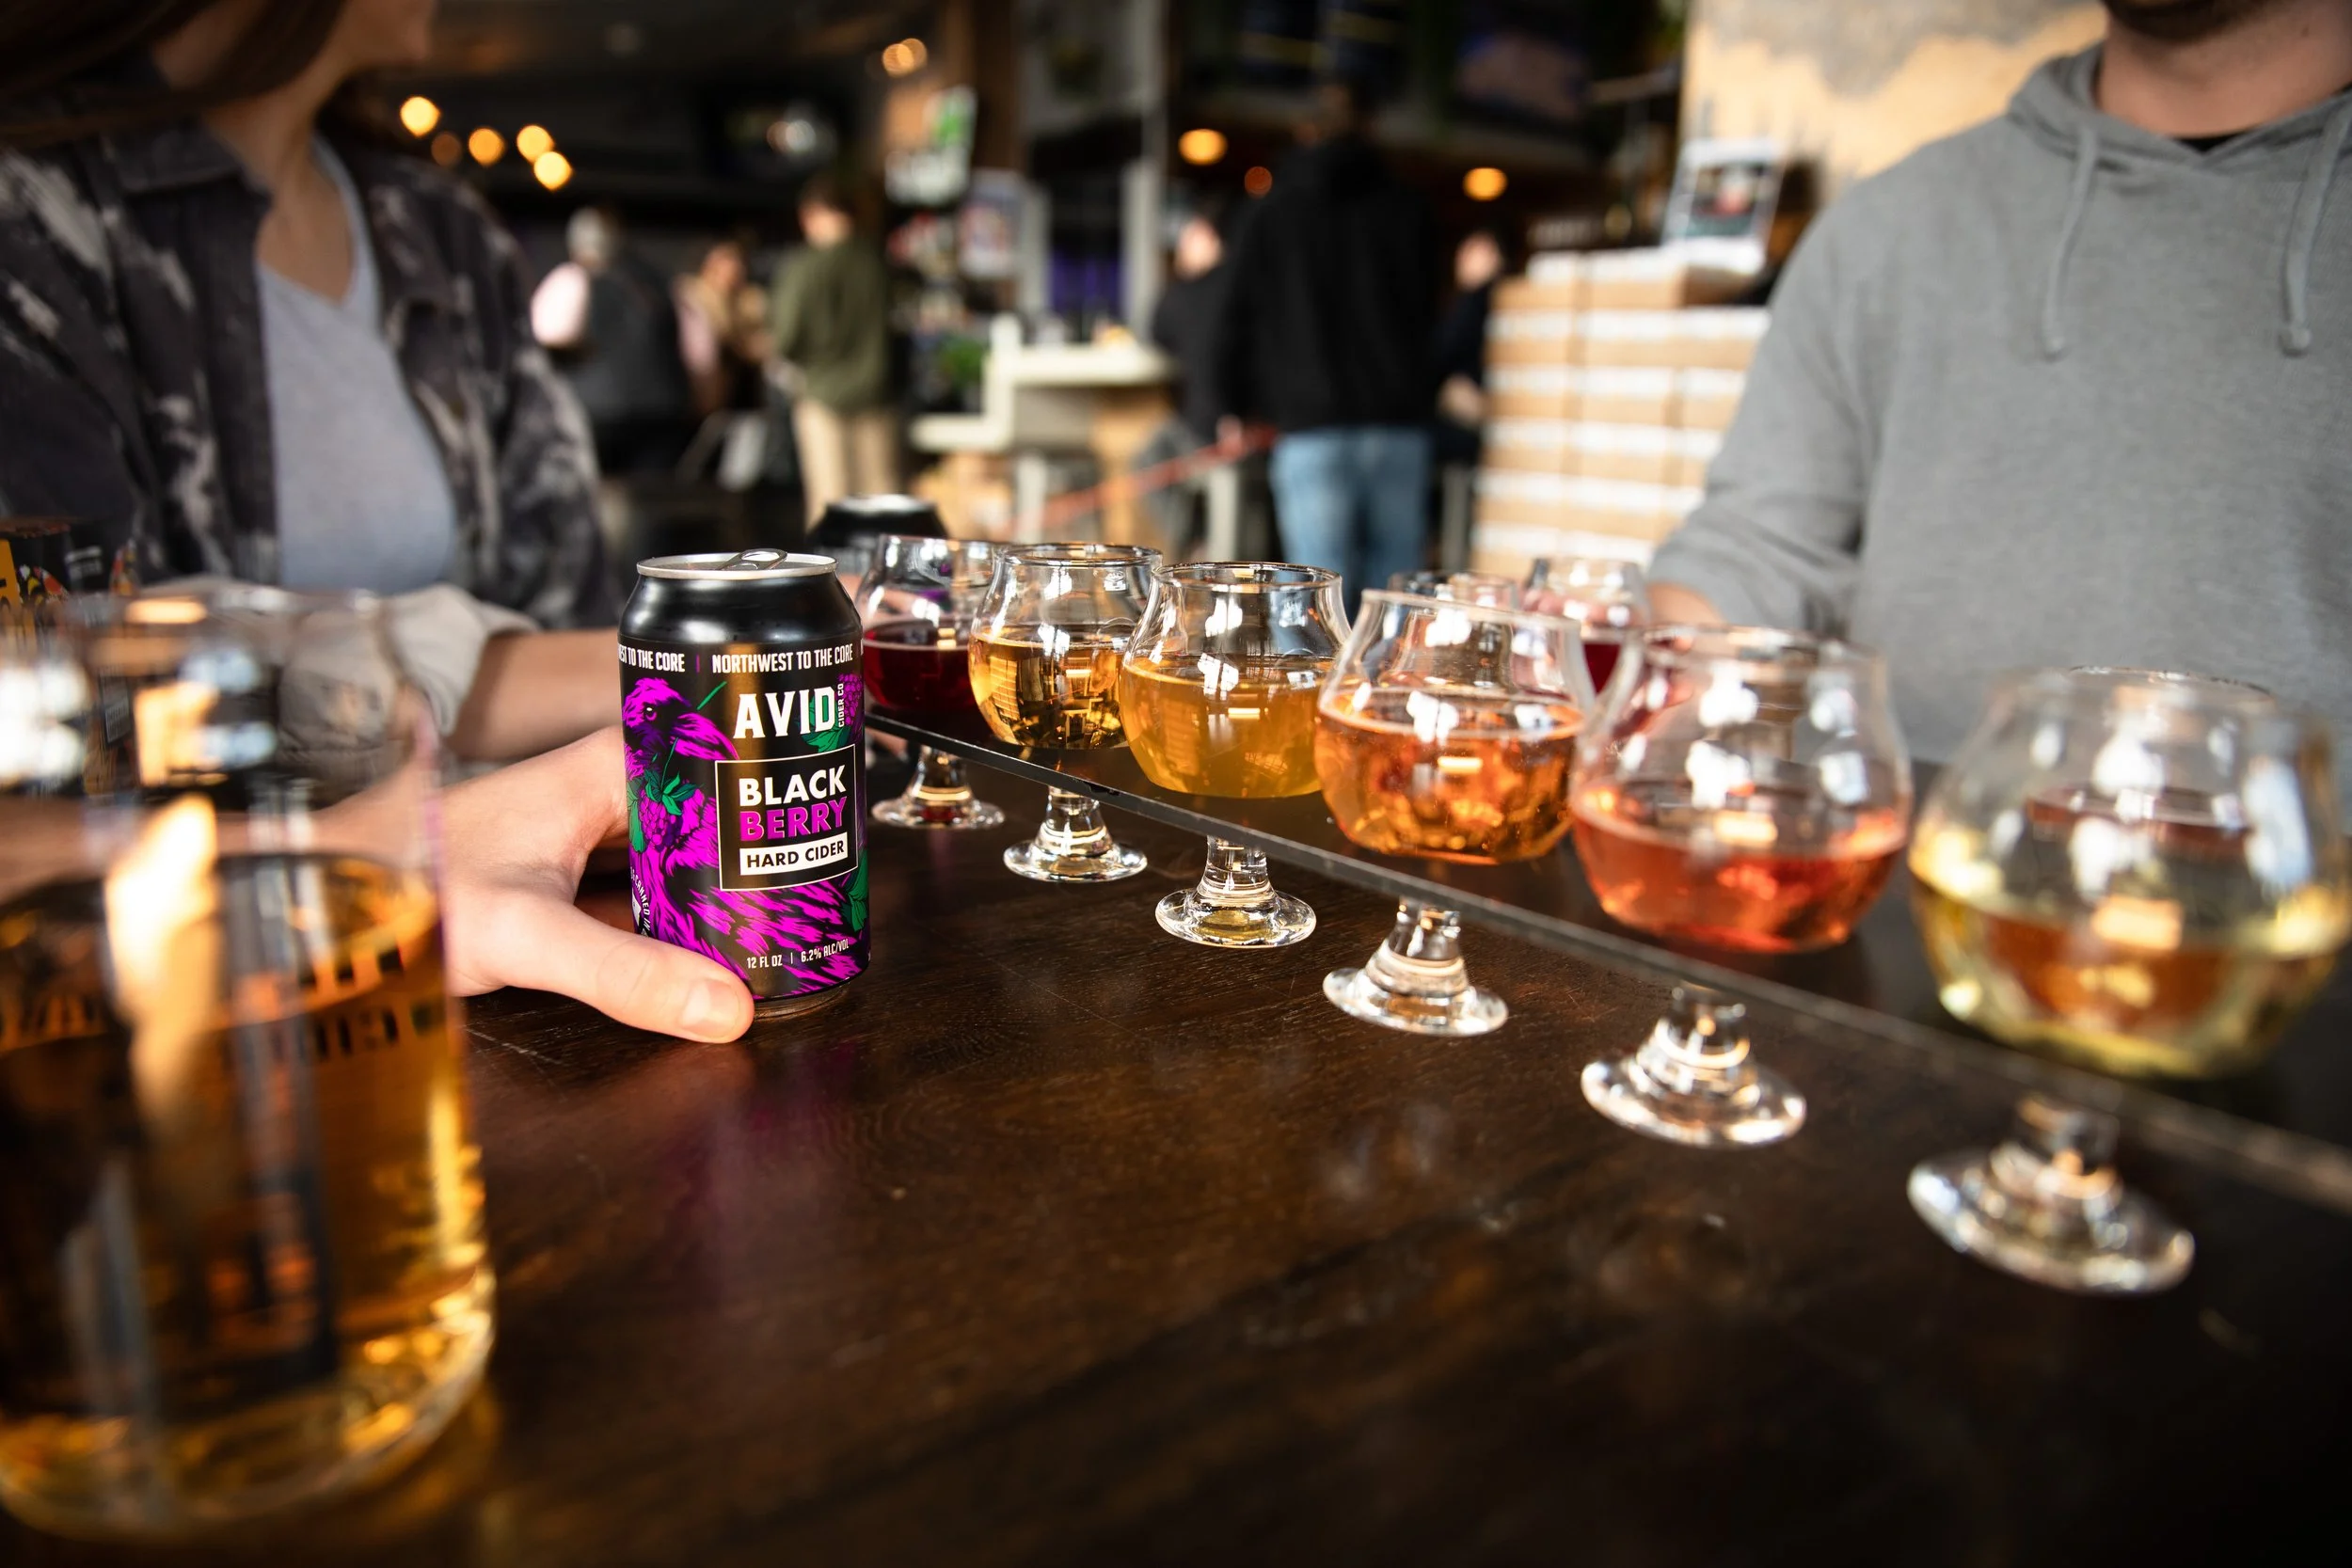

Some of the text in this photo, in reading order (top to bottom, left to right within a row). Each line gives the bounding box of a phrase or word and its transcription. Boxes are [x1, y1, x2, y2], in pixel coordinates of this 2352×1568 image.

[628, 647, 636, 666] TO
[637, 649, 654, 670] THE
[655, 652, 685, 673] CORE
[711, 653, 794, 673] NORTHWEST
[796, 650, 811, 670] TO
[814, 648, 833, 668] THE
[834, 643, 853, 664] CORE
[733, 686, 835, 739] AVID
[739, 765, 847, 806] BLACK
[739, 797, 848, 842] BERRY
[747, 840, 845, 868] HARD CIDER
[747, 955, 783, 969] 12 FL OZ
[801, 939, 850, 963] 6.2% ALC/VOL
